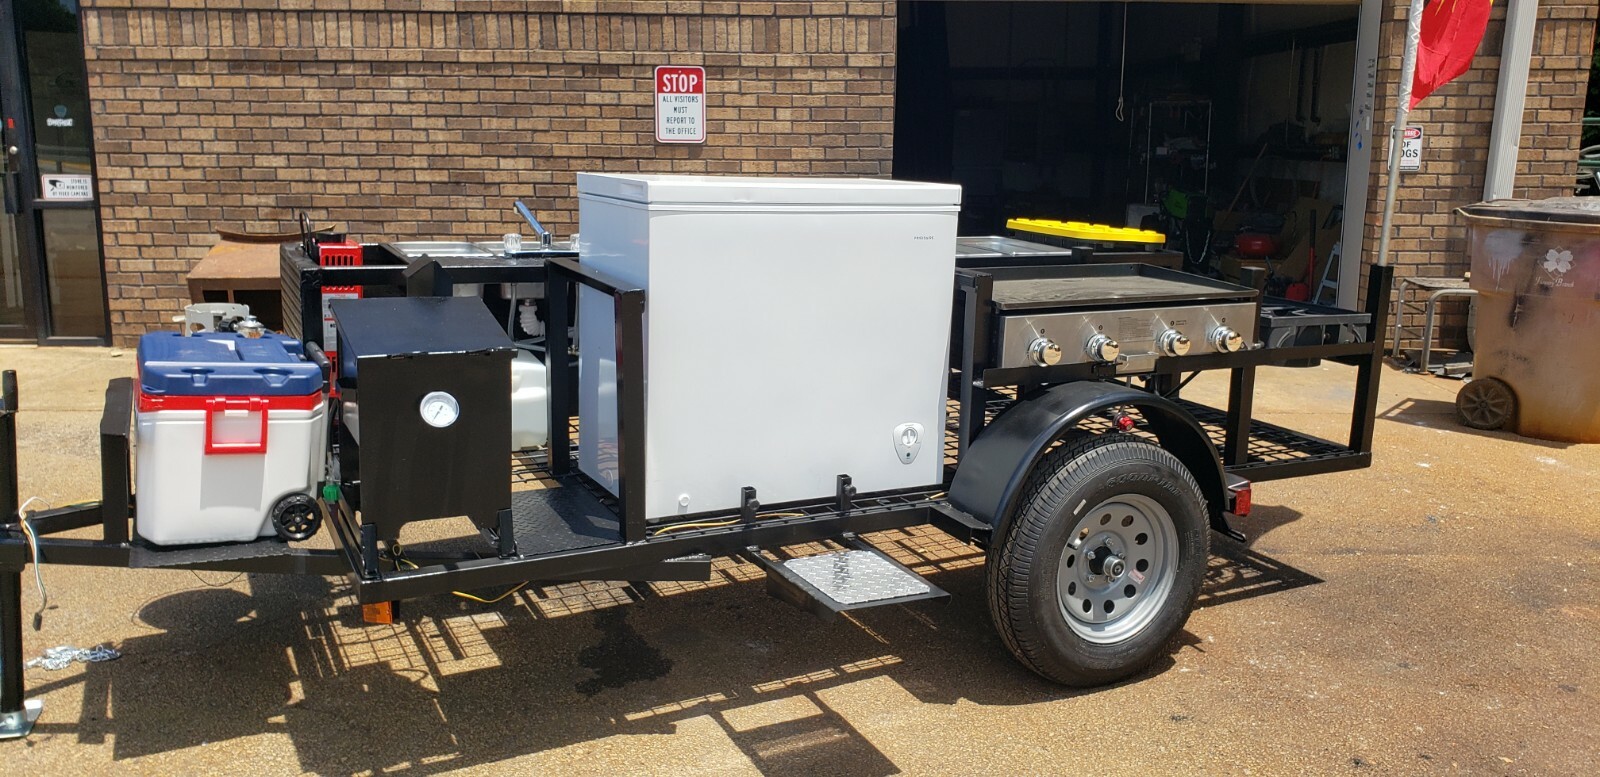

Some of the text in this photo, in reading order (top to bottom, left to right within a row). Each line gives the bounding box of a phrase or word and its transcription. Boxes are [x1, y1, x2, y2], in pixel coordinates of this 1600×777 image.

[662, 73, 698, 93] STOP
[662, 95, 699, 103] ALL VISITORS
[673, 106, 688, 114] MUST
[666, 116, 696, 125] REPORT TO
[665, 127, 697, 135] THE OFFICE
